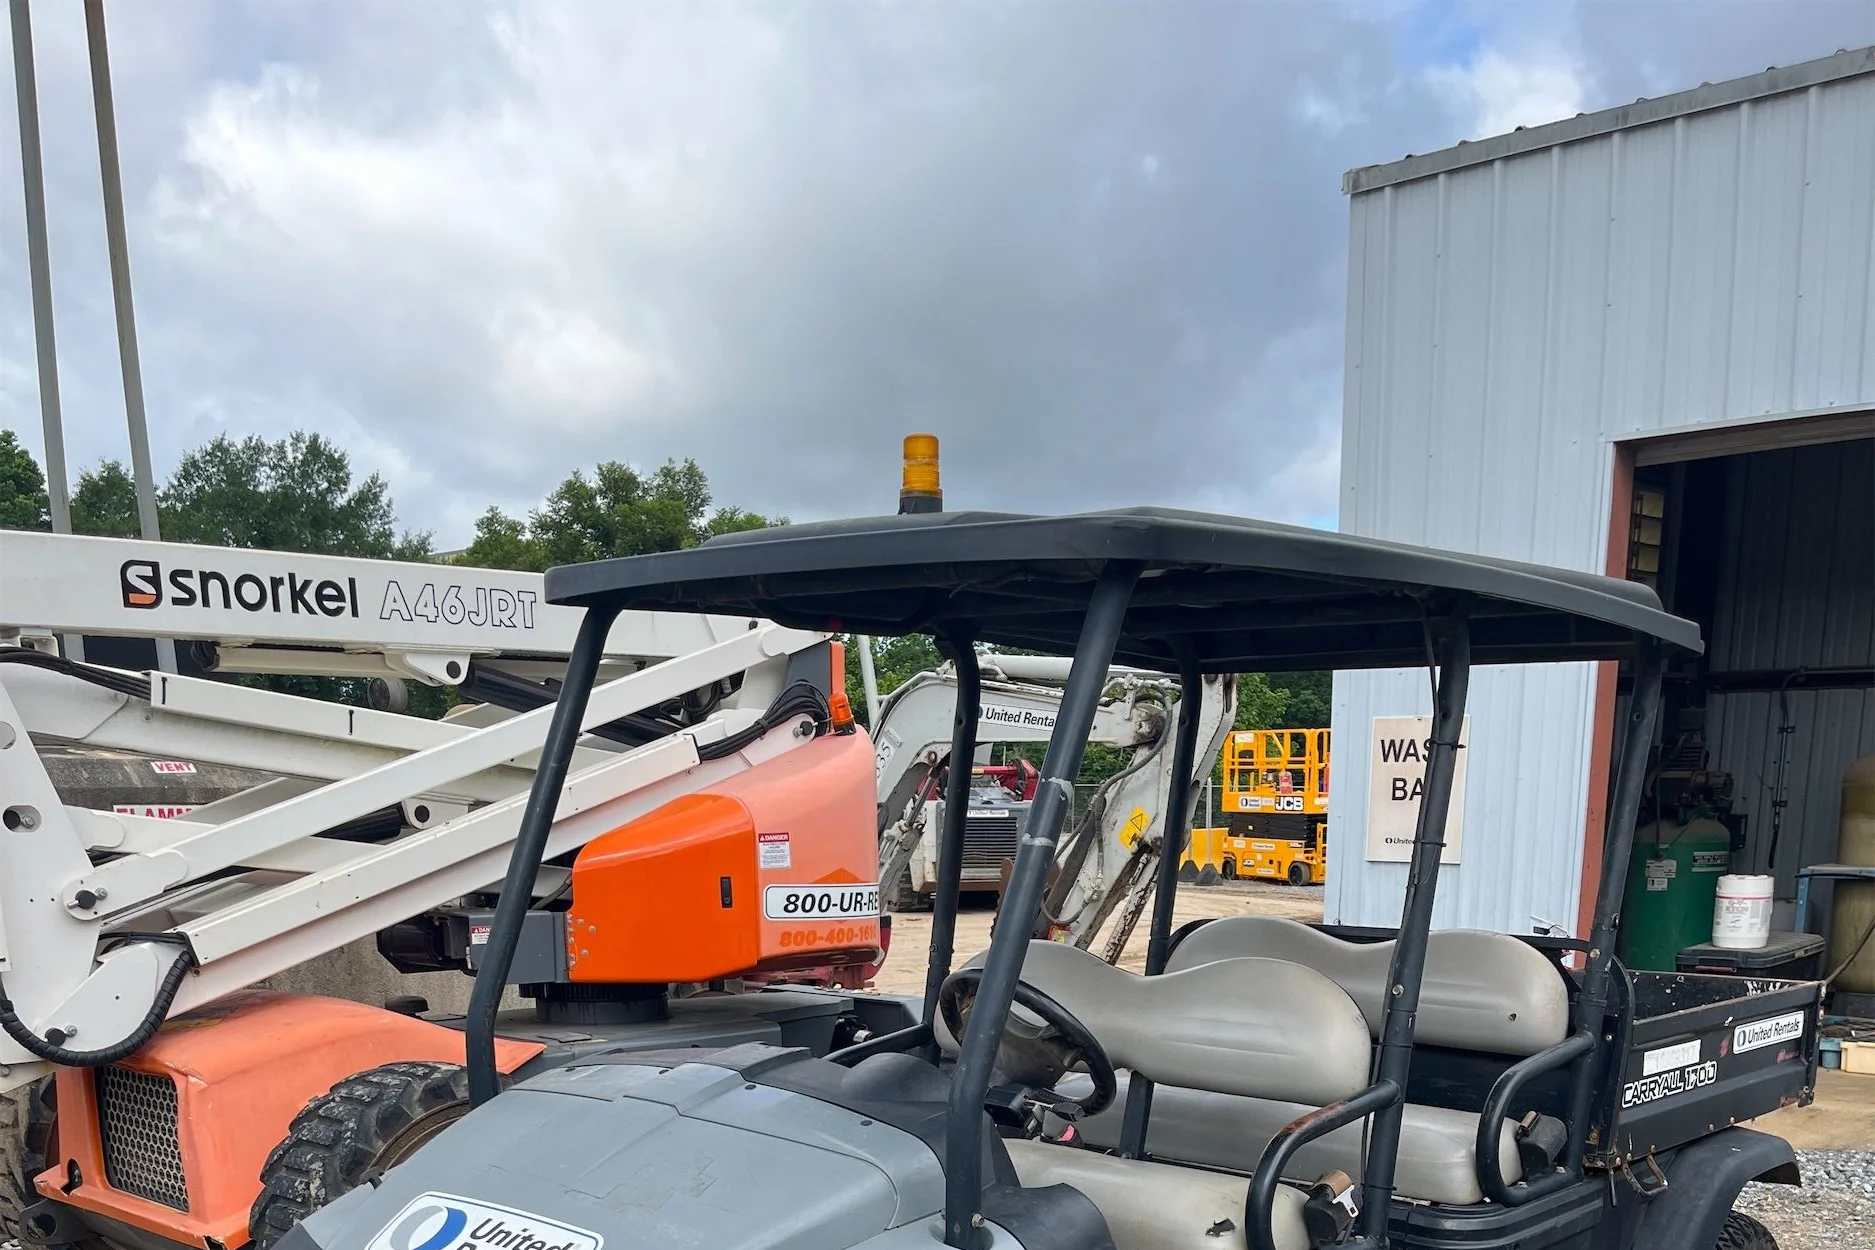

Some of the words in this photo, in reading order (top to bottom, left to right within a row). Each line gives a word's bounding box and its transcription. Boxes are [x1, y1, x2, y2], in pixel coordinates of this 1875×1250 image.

[169, 568, 359, 618] snorkel
[379, 580, 537, 629] A46JRT
[986, 707, 1022, 723] United
[1023, 712, 1055, 727] Renta
[1380, 738, 1432, 763] WAS
[154, 762, 192, 772] VENT
[1391, 777, 1425, 801] BA
[1275, 796, 1304, 811] JCB
[783, 891, 878, 914] 800-UR-RE
[1747, 1023, 1773, 1044] United
[1773, 1018, 1800, 1038] Rentals
[1622, 1070, 1685, 1108] CARRYALL
